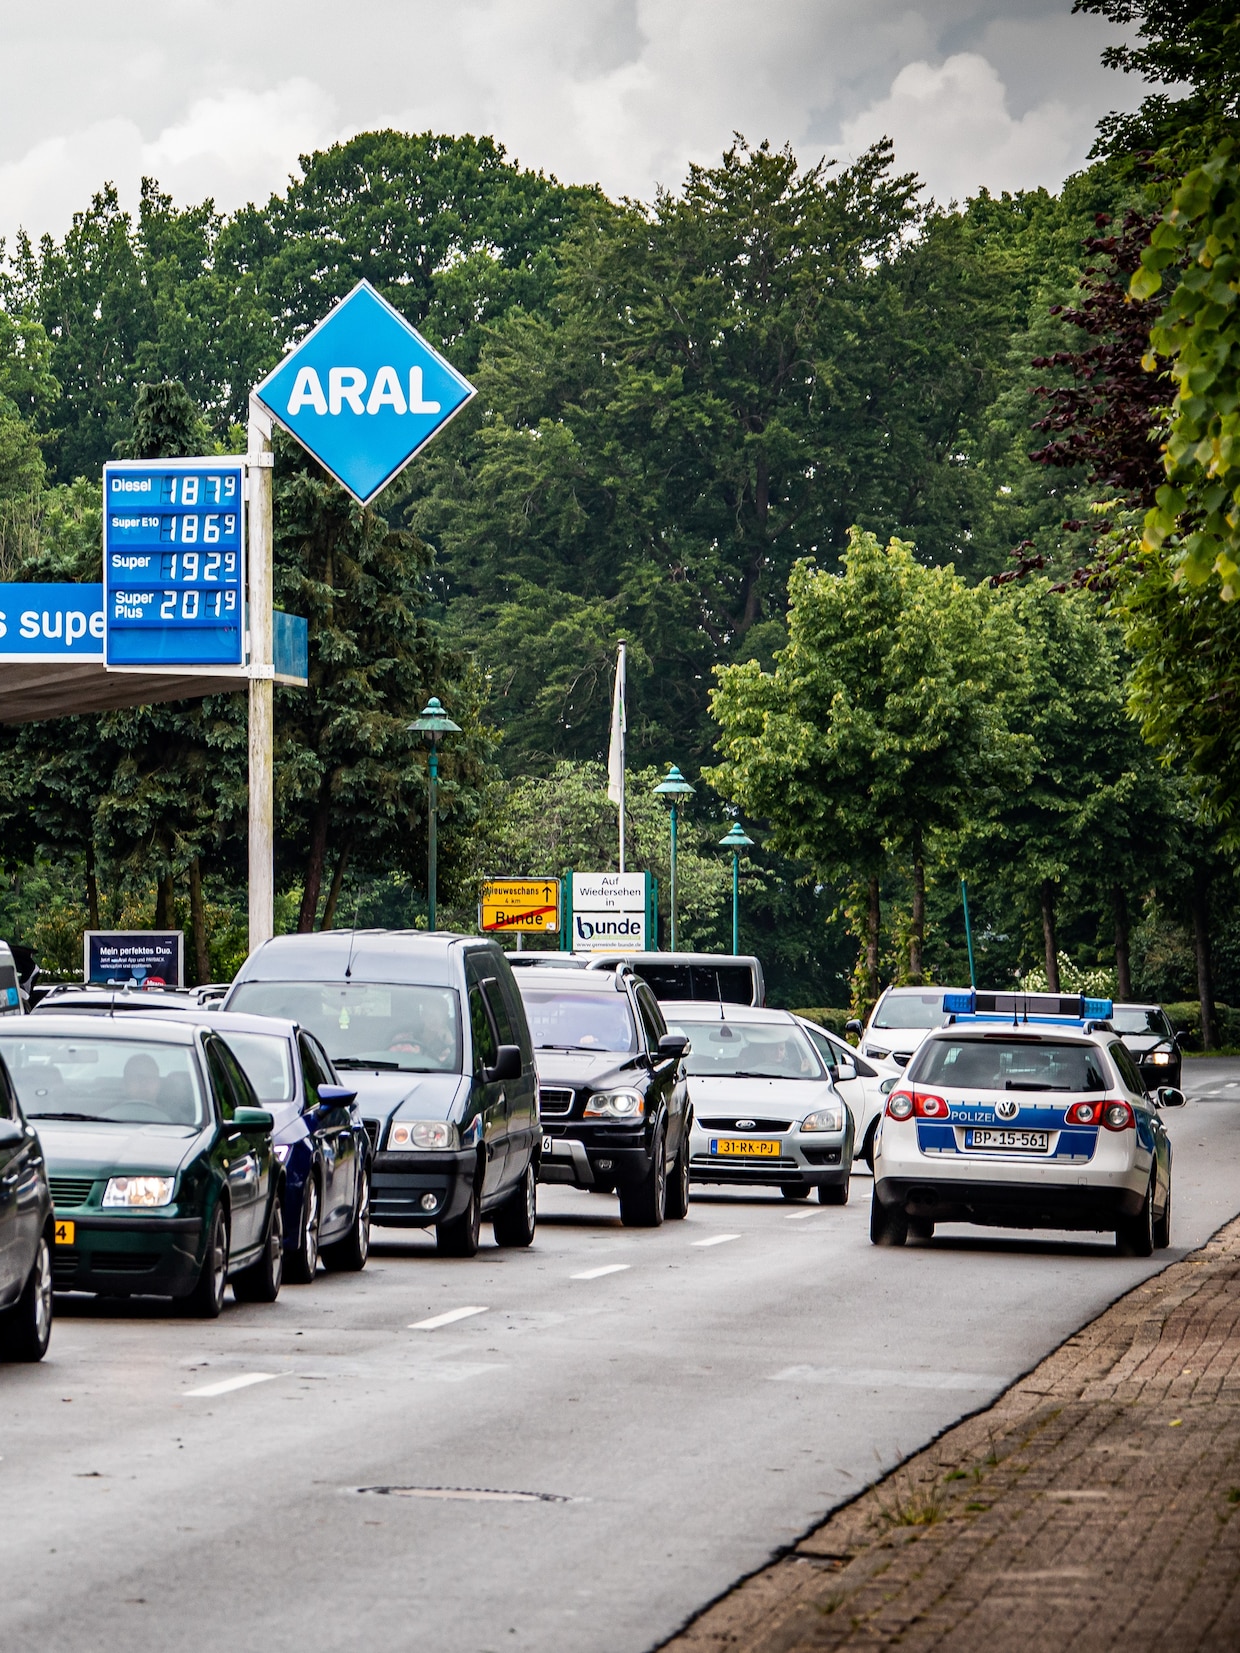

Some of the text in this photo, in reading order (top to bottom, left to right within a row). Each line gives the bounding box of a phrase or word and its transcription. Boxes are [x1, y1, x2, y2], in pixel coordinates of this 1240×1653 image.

[287, 366, 441, 416] ARAL
[112, 478, 152, 492] Diesel
[112, 517, 140, 529] Super
[141, 517, 159, 527] E10
[112, 554, 151, 570] Super
[115, 591, 154, 606] Super
[115, 605, 143, 619] Plus
[19, 610, 104, 646] supe
[601, 877, 619, 885] Auf
[579, 887, 641, 896] Wiedersehen
[605, 898, 615, 906] in
[495, 911, 543, 925] Bunde
[576, 916, 641, 940] bunde
[100, 946, 172, 957] Mein perfektes Duo.
[951, 1111, 995, 1123] POLIZEI
[543, 1138, 550, 1150] 6
[724, 1141, 774, 1154] 31-RK-PJ
[56, 1224, 67, 1241] 4
